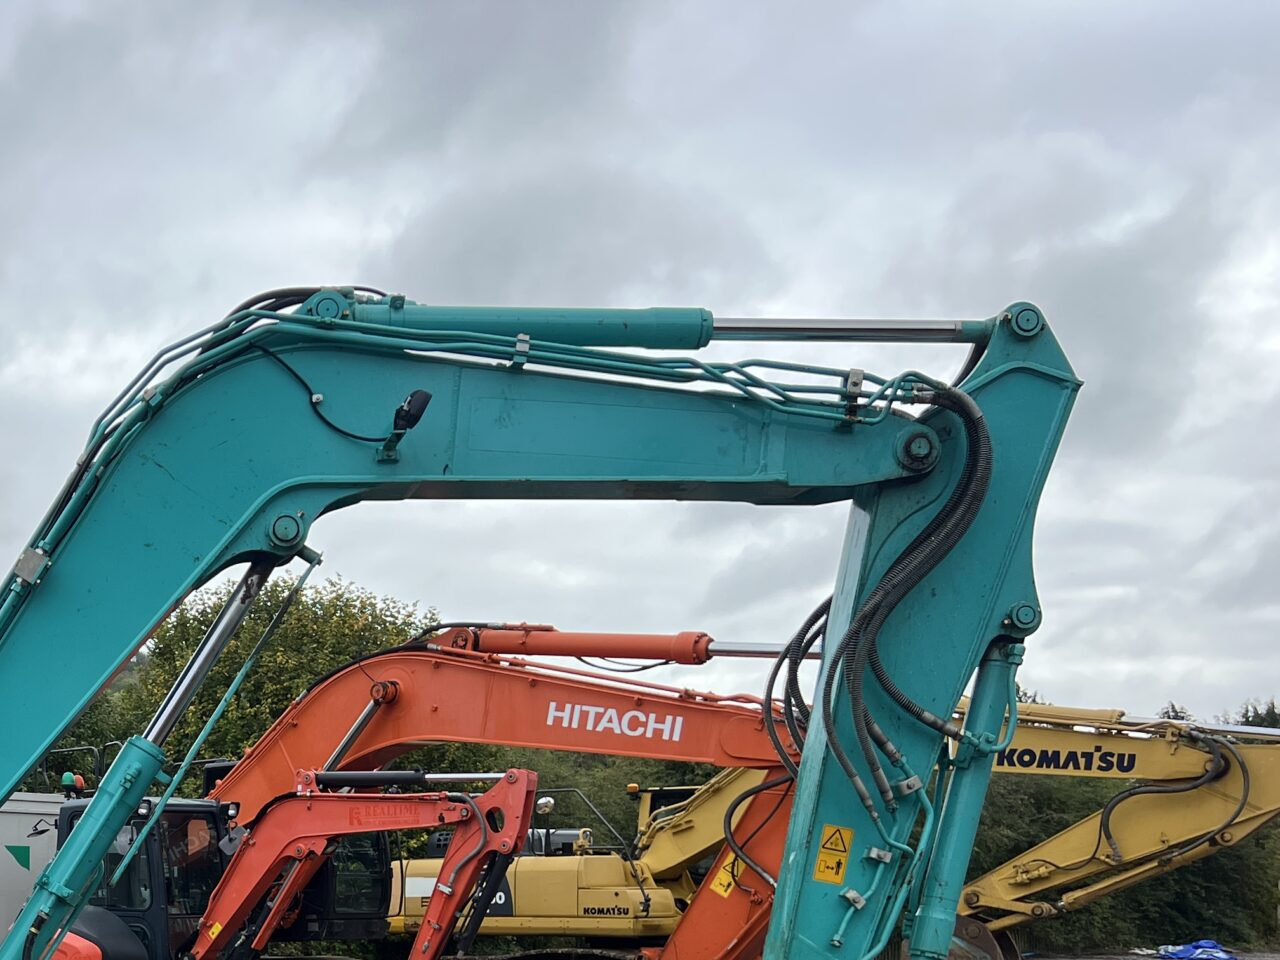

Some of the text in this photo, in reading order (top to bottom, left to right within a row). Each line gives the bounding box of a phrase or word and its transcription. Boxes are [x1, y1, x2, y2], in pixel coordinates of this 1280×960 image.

[546, 701, 684, 742] HITACHI
[996, 745, 1136, 773] KOMATSU
[583, 903, 629, 916] KOMATSU
